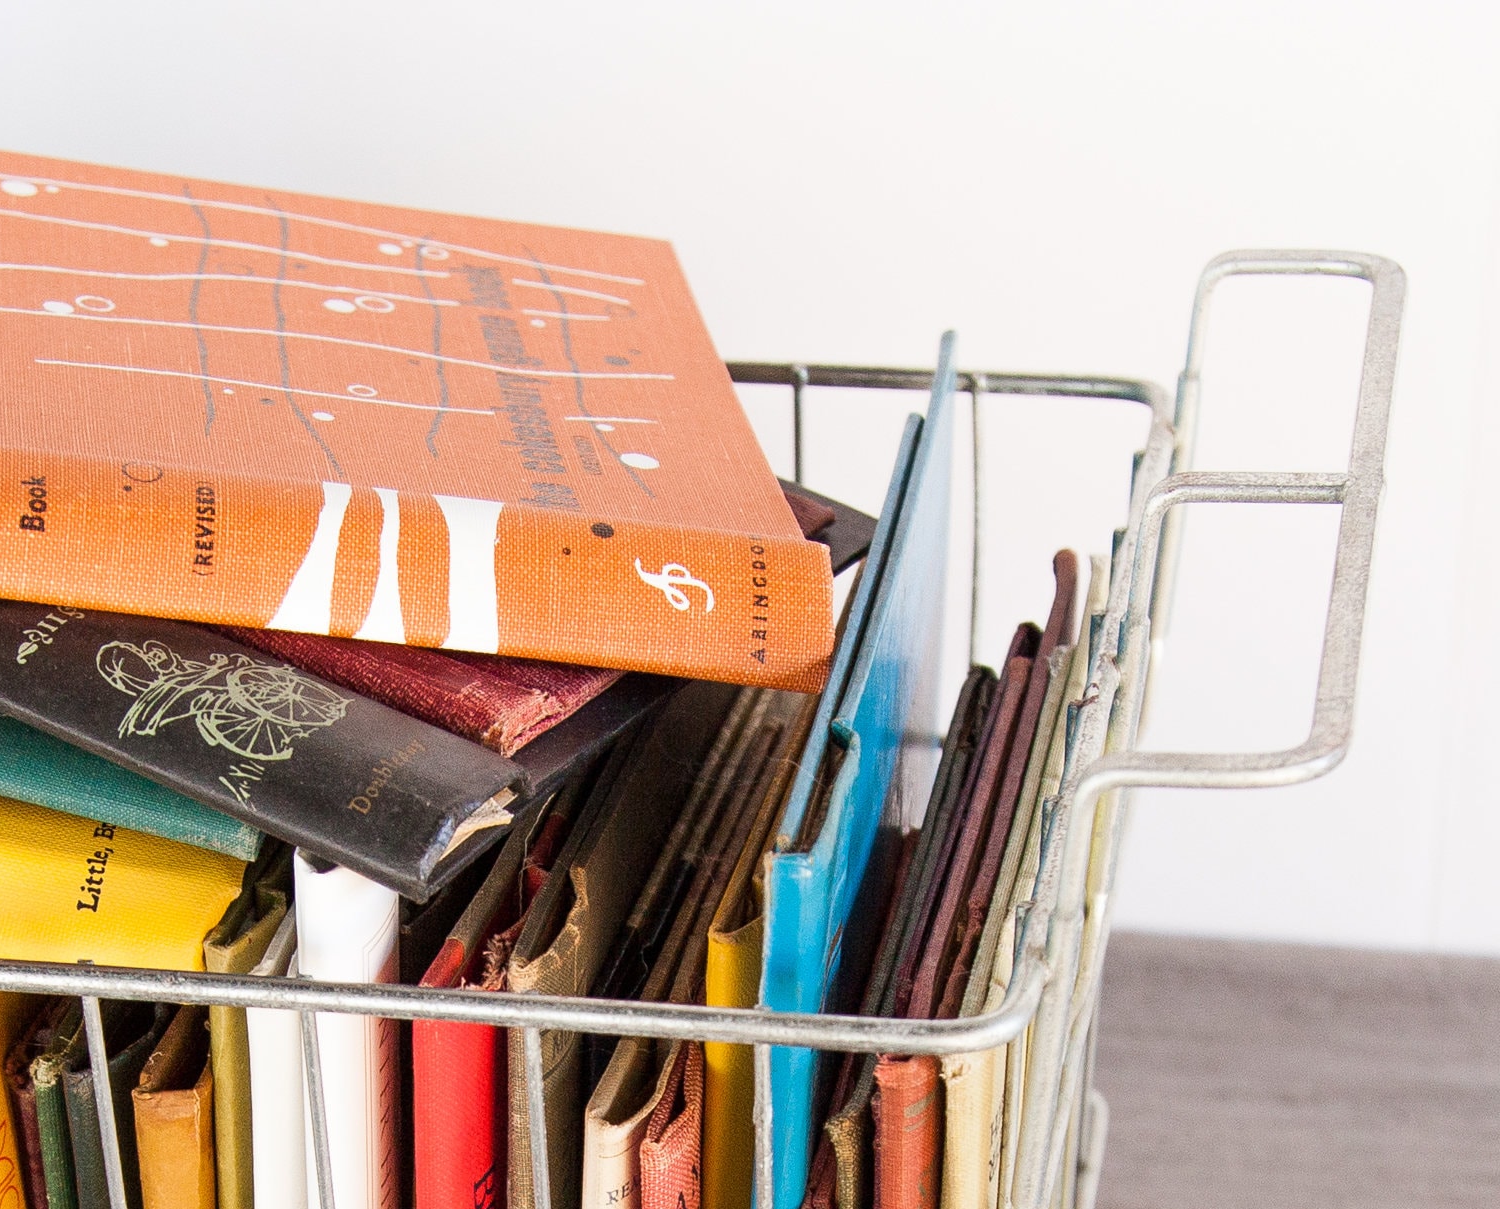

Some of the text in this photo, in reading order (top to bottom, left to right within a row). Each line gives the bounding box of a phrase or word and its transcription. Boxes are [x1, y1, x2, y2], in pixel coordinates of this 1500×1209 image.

[19, 475, 49, 532] Book
[749, 536, 768, 665] ABINGDO
[346, 736, 428, 818] Doubleday
[77, 848, 113, 913] Little,
